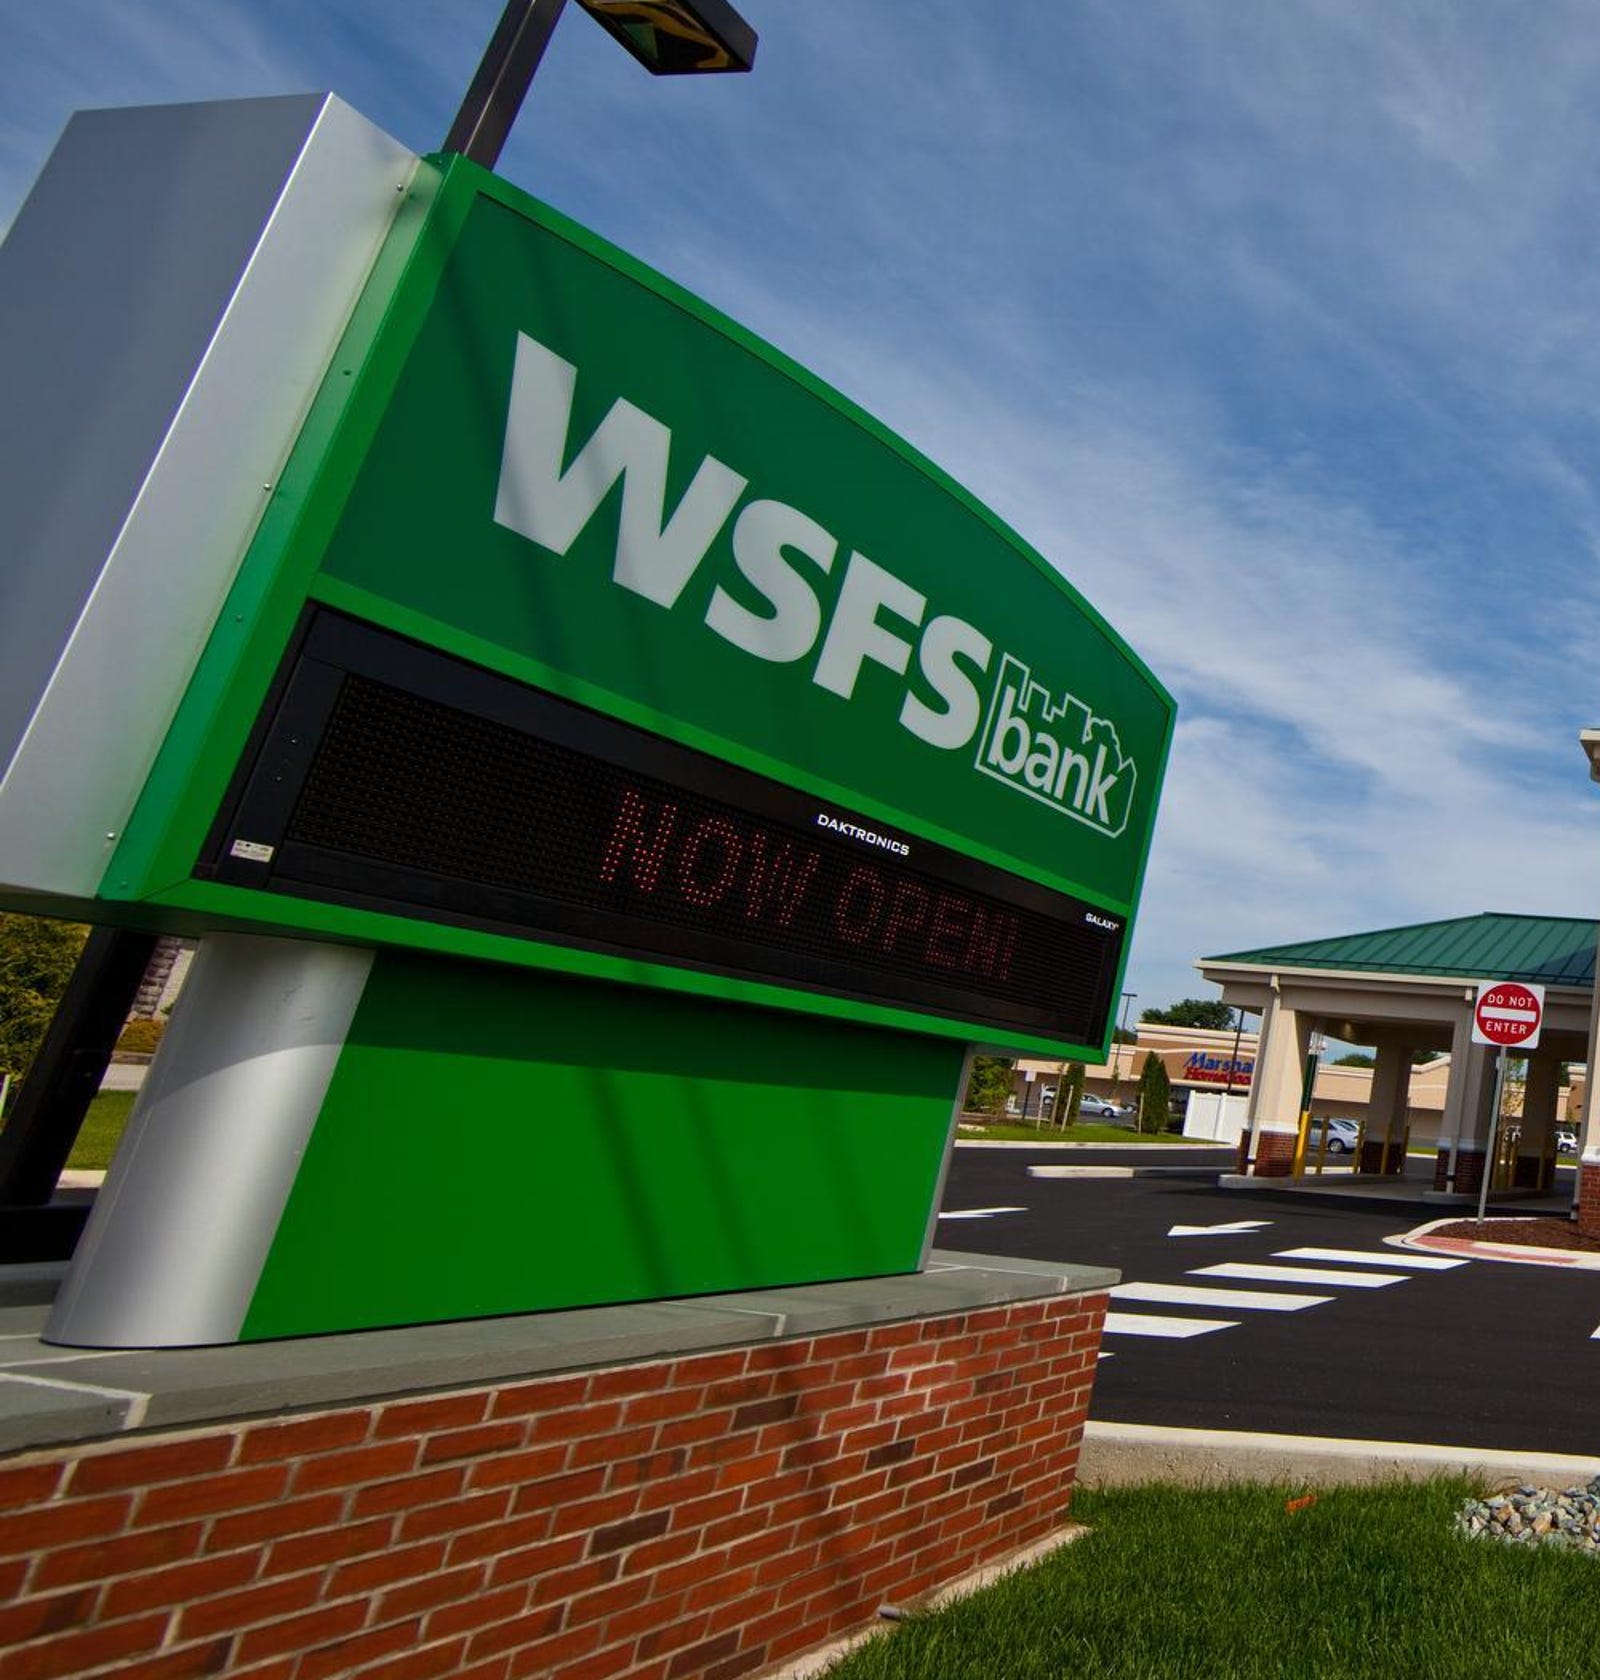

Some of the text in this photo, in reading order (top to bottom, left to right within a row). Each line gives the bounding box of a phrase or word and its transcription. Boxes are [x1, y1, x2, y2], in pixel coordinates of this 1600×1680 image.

[493, 329, 1118, 824] WSFS bank
[817, 813, 910, 856] DAKTRONICS
[600, 790, 820, 925] NOW
[1487, 993, 1533, 1008] DO NOT
[1485, 1021, 1527, 1035] ENTER
